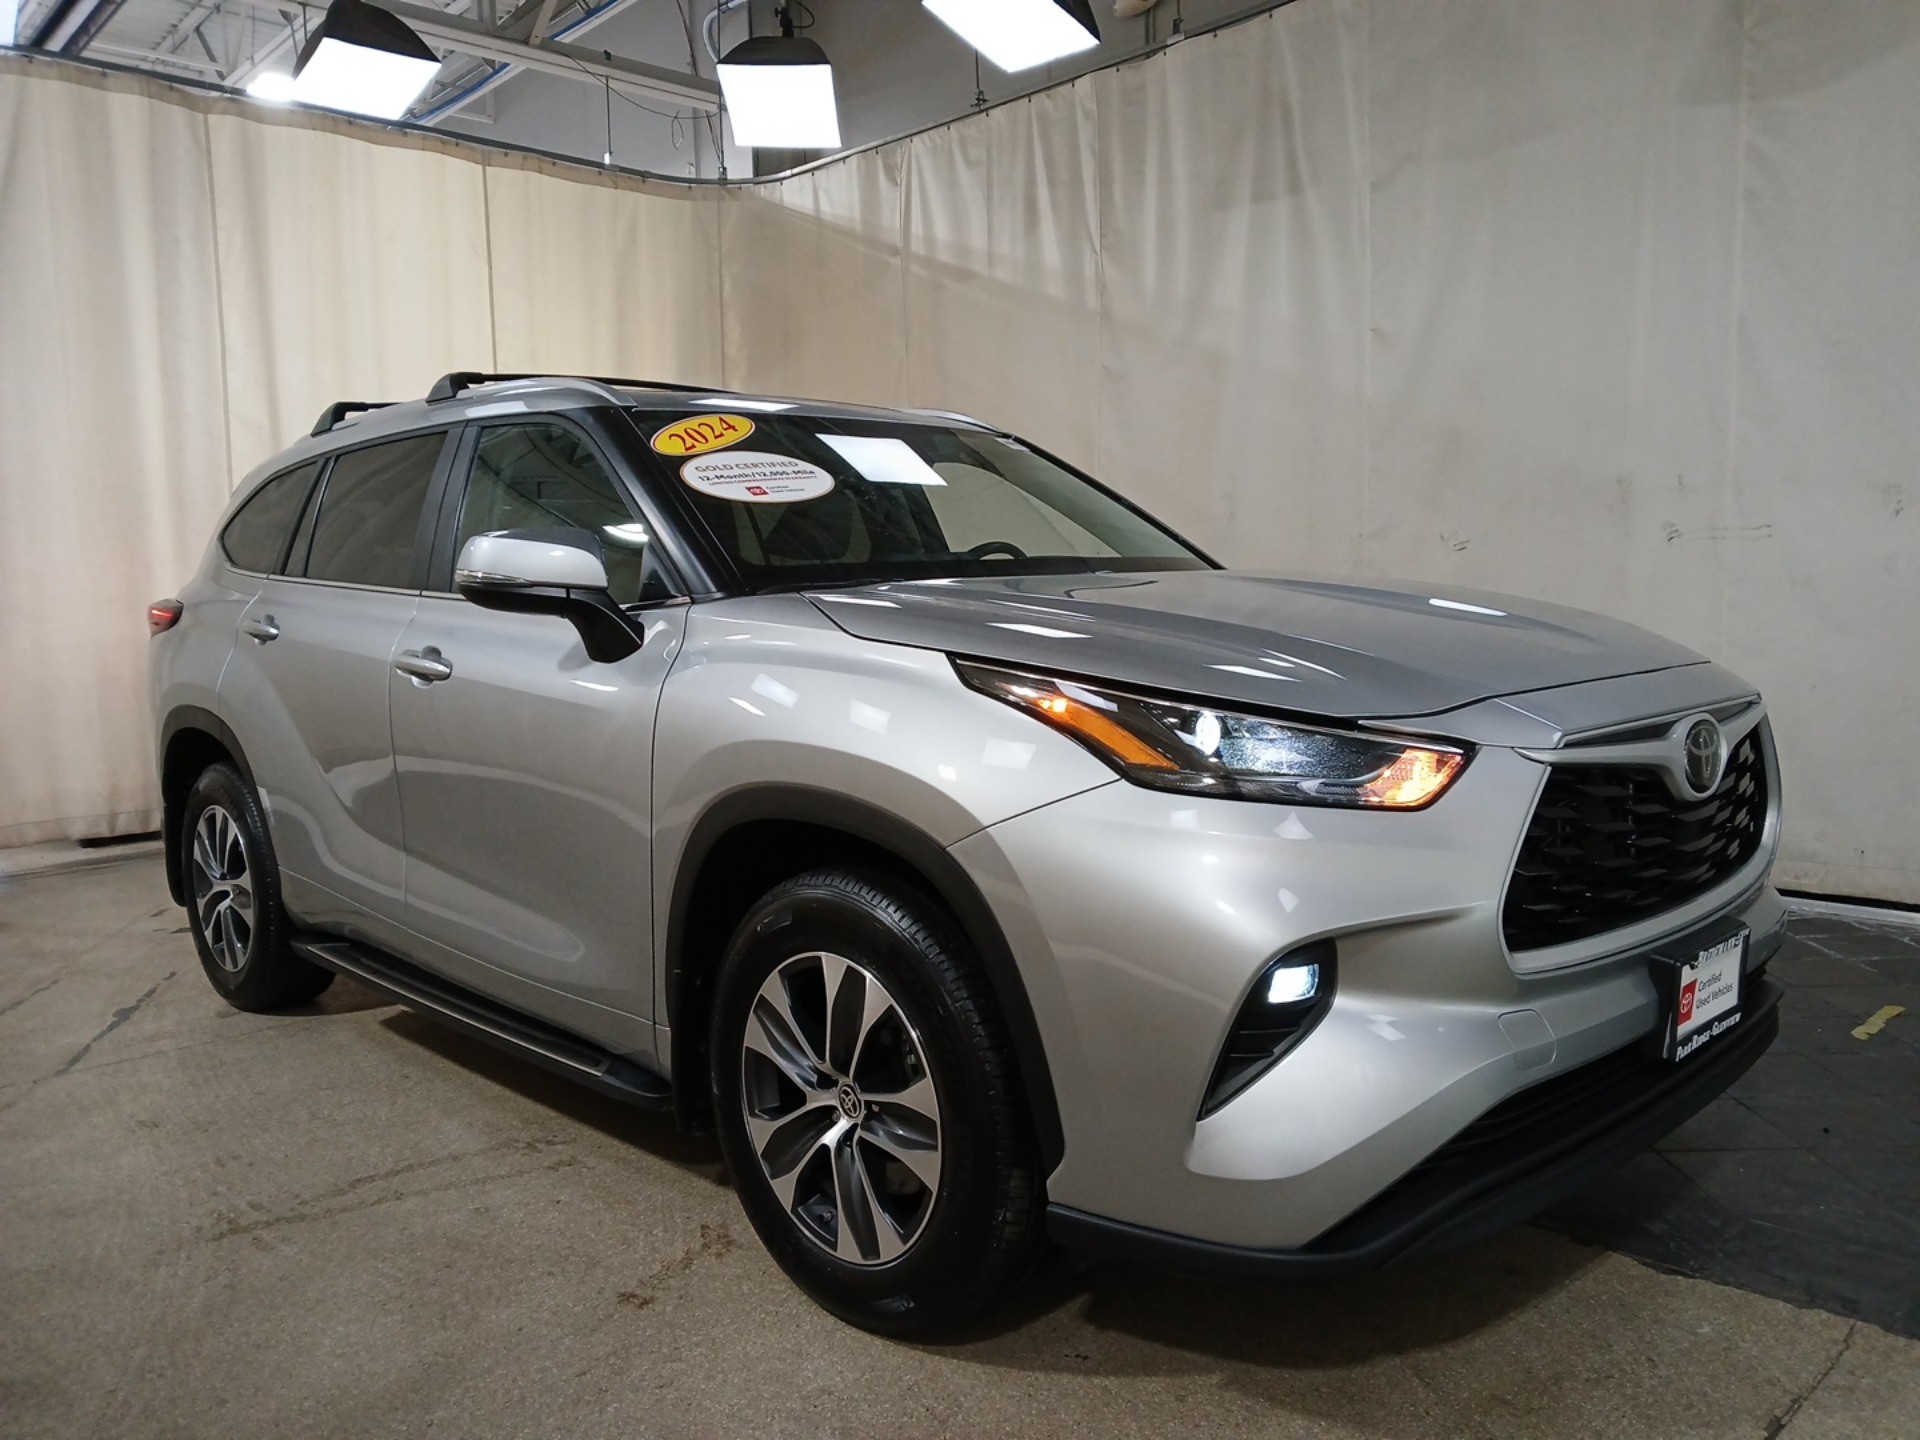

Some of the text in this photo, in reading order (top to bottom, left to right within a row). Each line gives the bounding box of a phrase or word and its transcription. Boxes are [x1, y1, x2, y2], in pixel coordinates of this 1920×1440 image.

[668, 415, 739, 452] 2024
[694, 460, 798, 472] GOLD CERTIFIED
[1698, 970, 1722, 992] Certified
[1695, 982, 1733, 1009] Used Vehicles
